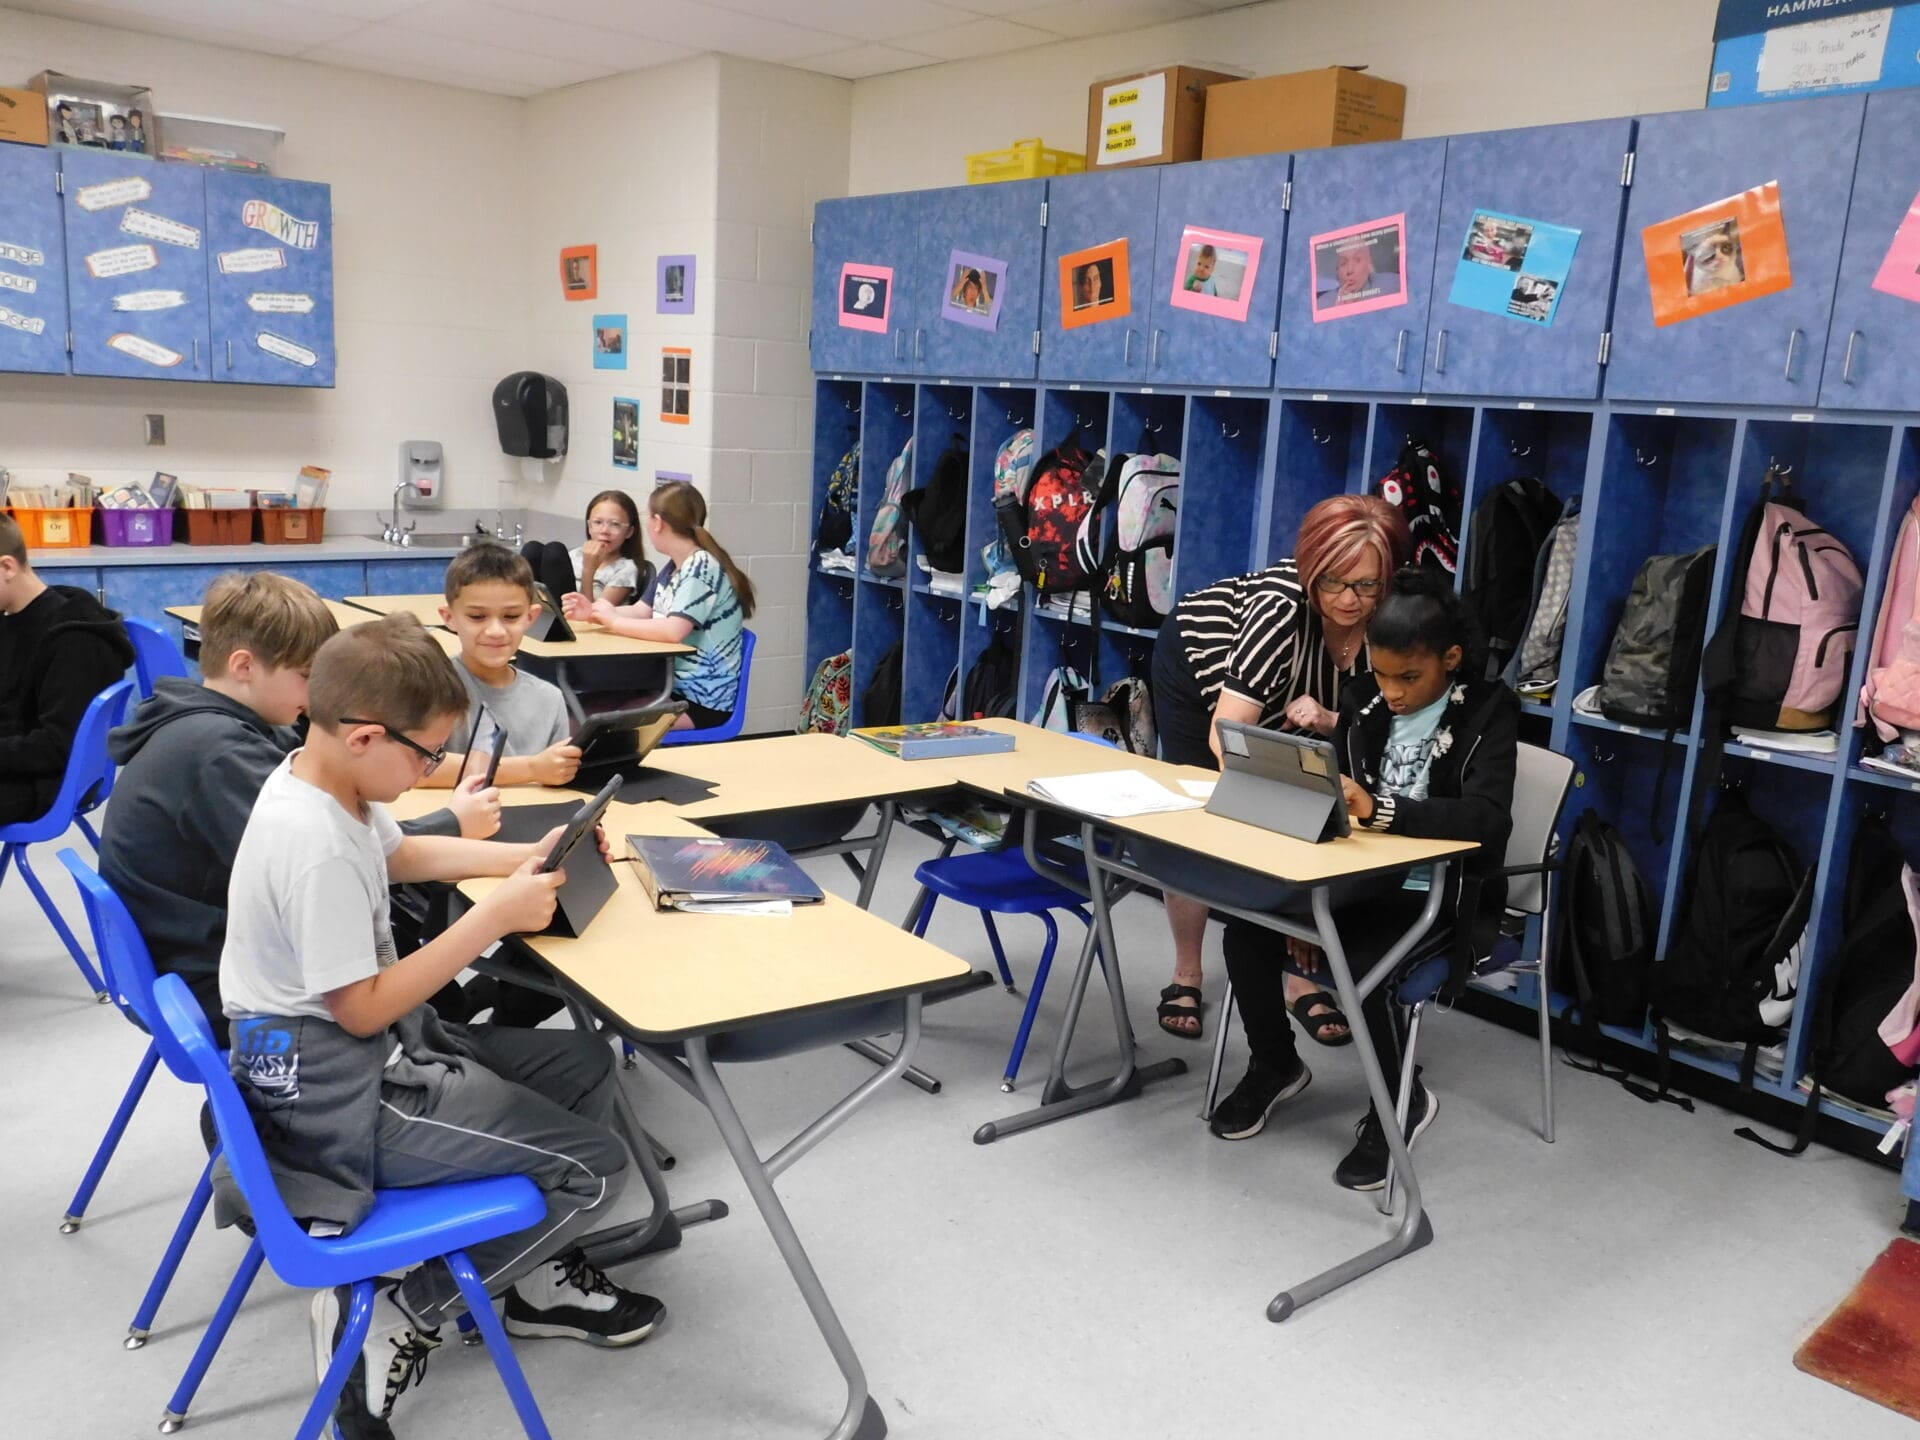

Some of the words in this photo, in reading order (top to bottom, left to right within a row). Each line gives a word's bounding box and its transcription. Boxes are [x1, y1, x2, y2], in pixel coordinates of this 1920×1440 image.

[1766, 0, 1854, 18] HAMME
[1119, 93, 1138, 103] Grade
[1106, 142, 1123, 151] Room
[1123, 138, 1136, 147] 203
[244, 201, 317, 248] GROWTH
[1370, 797, 1396, 830] PIN
